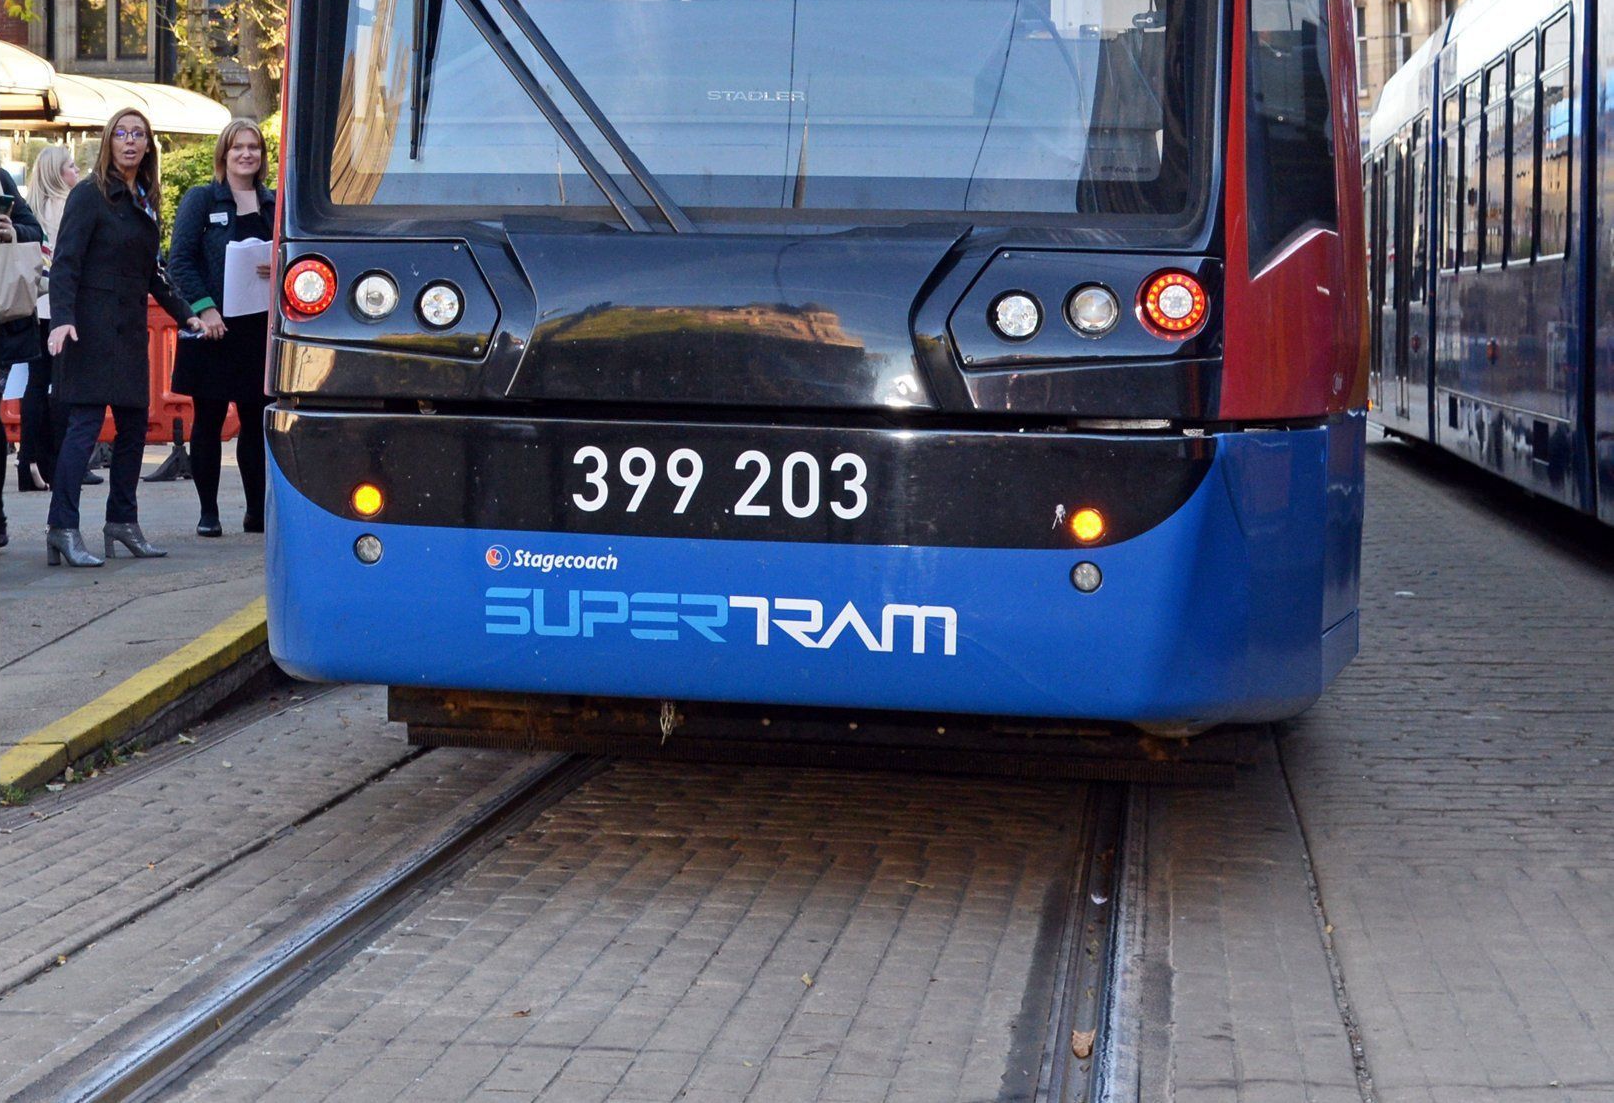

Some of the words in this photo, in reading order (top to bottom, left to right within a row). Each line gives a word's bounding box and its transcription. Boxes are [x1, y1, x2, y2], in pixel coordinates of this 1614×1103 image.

[706, 90, 805, 102] STADLER
[572, 445, 704, 514] 399
[734, 449, 868, 520] 203
[513, 549, 618, 573] Stagecoach
[486, 586, 958, 656] SUPERTRAM
